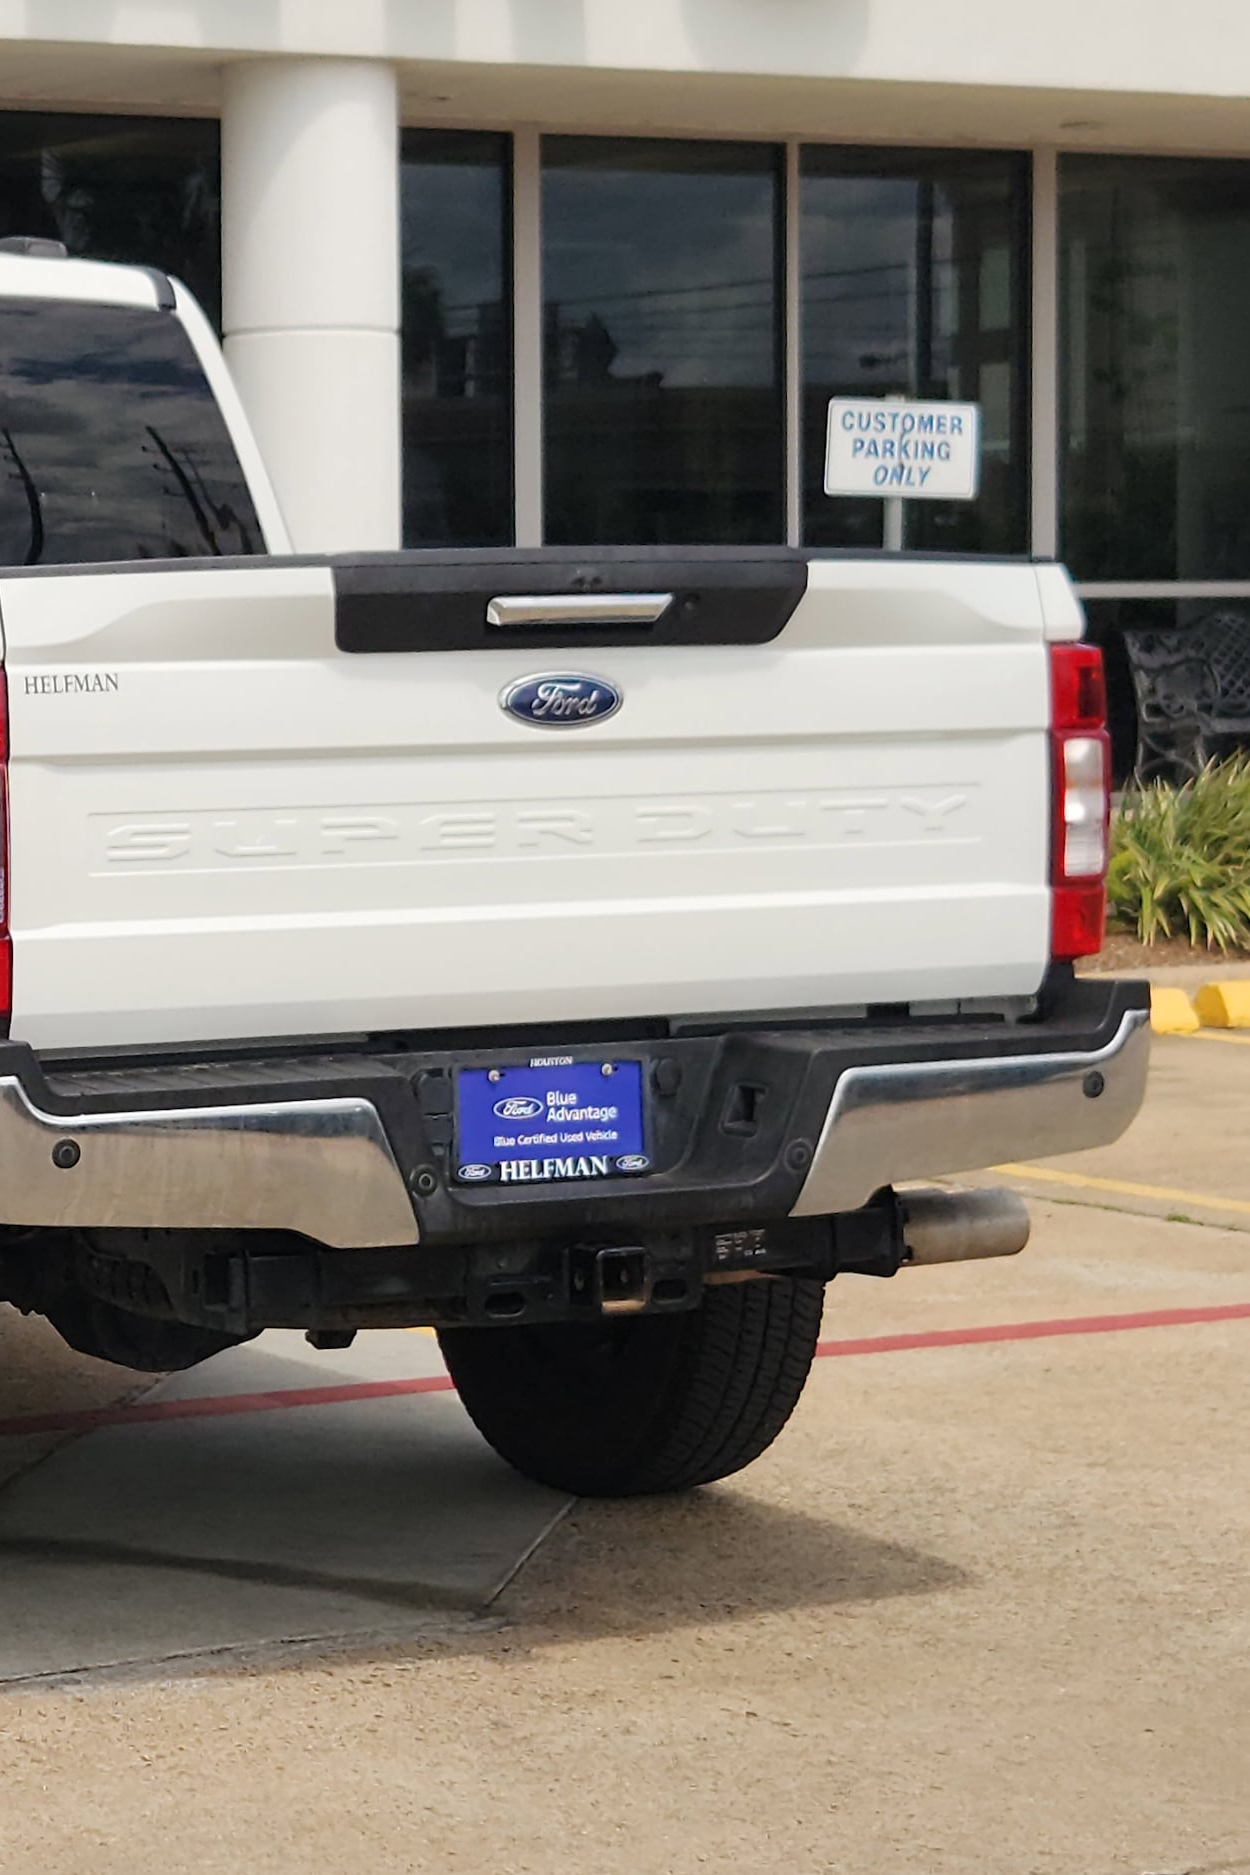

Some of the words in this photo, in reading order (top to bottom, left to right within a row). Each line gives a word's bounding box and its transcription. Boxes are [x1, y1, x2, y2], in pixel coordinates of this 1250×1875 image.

[841, 411, 963, 436] CUSTOMER
[852, 438, 951, 461] PARKING
[873, 465, 931, 487] ONLY
[24, 673, 119, 694] HELFMAN
[531, 682, 599, 716] Ford
[106, 808, 594, 862] SUPER
[635, 794, 967, 843] DUTY
[529, 1055, 573, 1068] HOUSTON
[502, 1100, 535, 1116] Ford
[546, 1091, 577, 1106] Blue
[546, 1106, 618, 1122] Advantage
[493, 1135, 516, 1147] Blue
[518, 1132, 558, 1145] Certified
[560, 1131, 584, 1143] Used
[585, 1129, 618, 1141] Vehicle
[499, 1155, 609, 1181] HELFMAN
